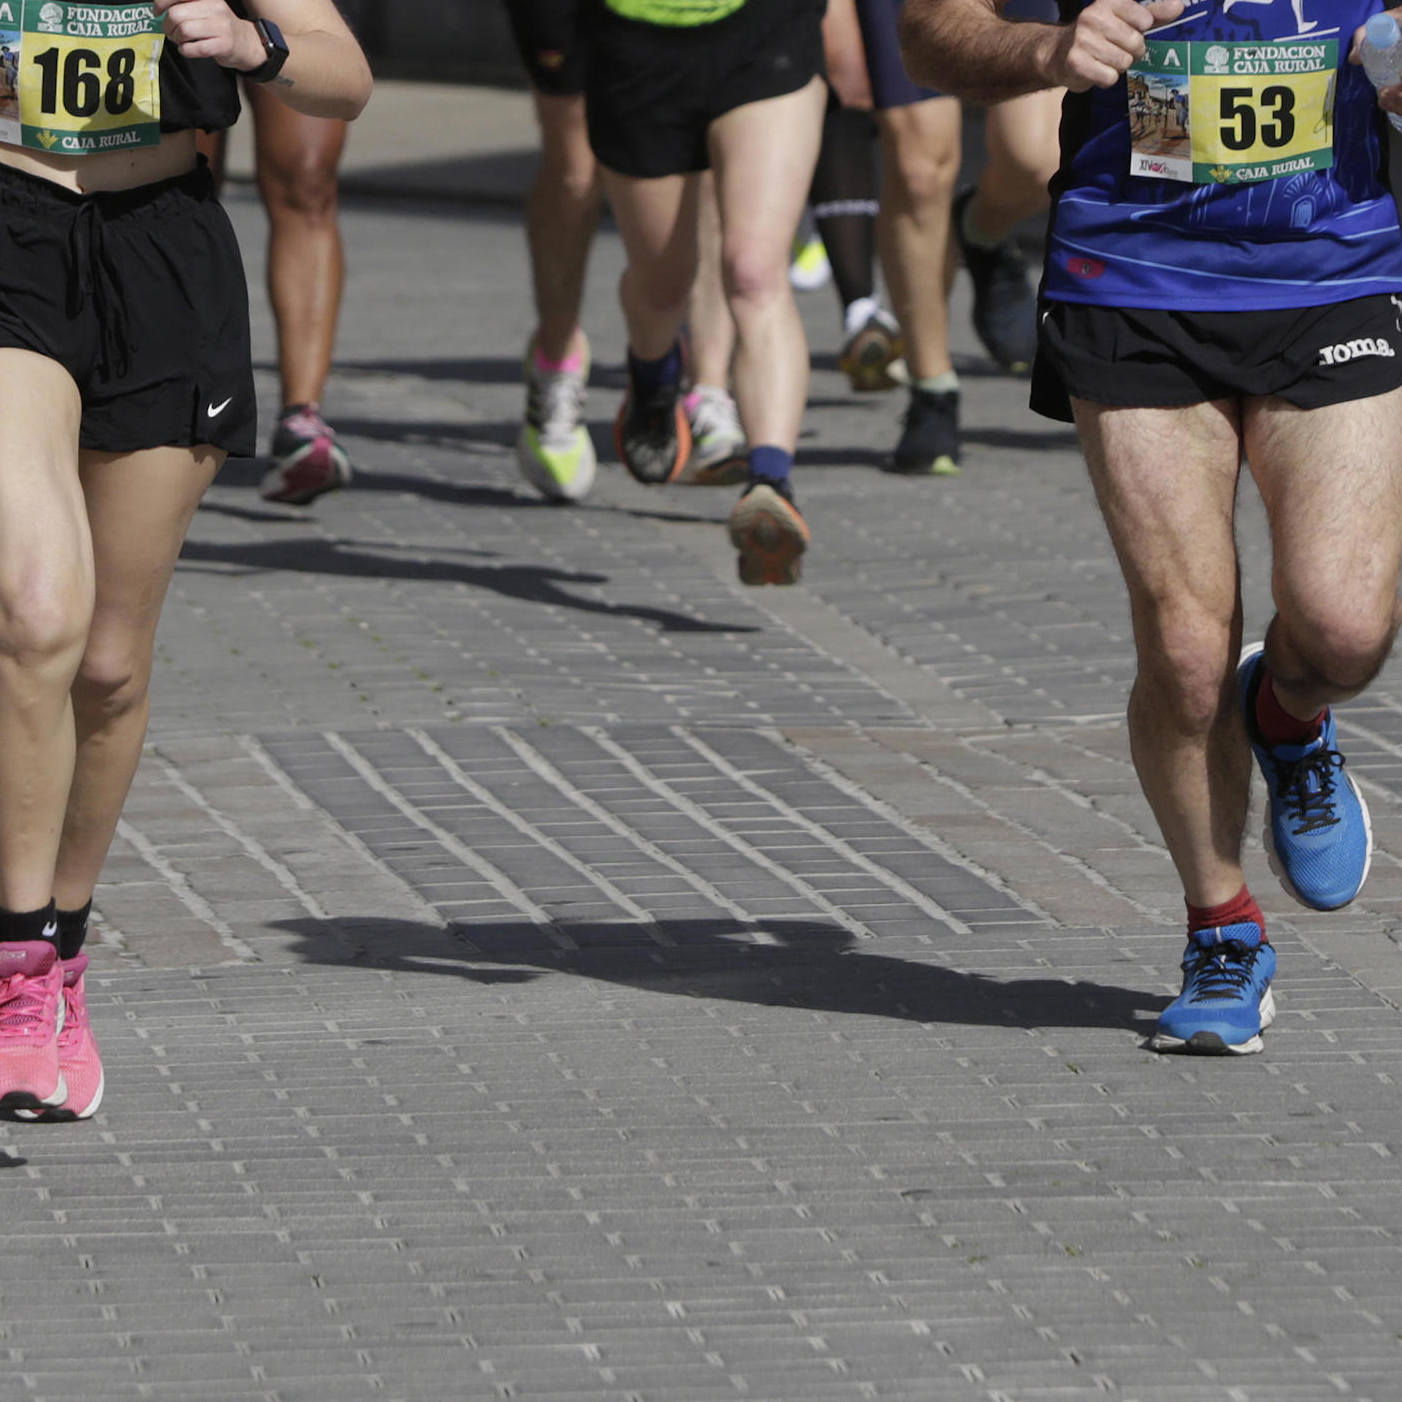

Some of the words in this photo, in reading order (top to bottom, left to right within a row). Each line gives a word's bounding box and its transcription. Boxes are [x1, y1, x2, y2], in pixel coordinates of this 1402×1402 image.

[66, 5, 156, 23] FUNDACION
[66, 21, 106, 38] CAJA
[107, 20, 153, 36] RURAL
[1233, 45, 1326, 60] FUNDACION
[1233, 59, 1271, 74] CAJA
[1273, 58, 1326, 74] RURAL
[33, 47, 136, 118] 168
[1219, 85, 1296, 151] 53
[61, 135, 97, 149] CAJA
[98, 130, 142, 148] RURAL
[1235, 164, 1268, 180] CAJA
[1271, 156, 1315, 175] RURAL
